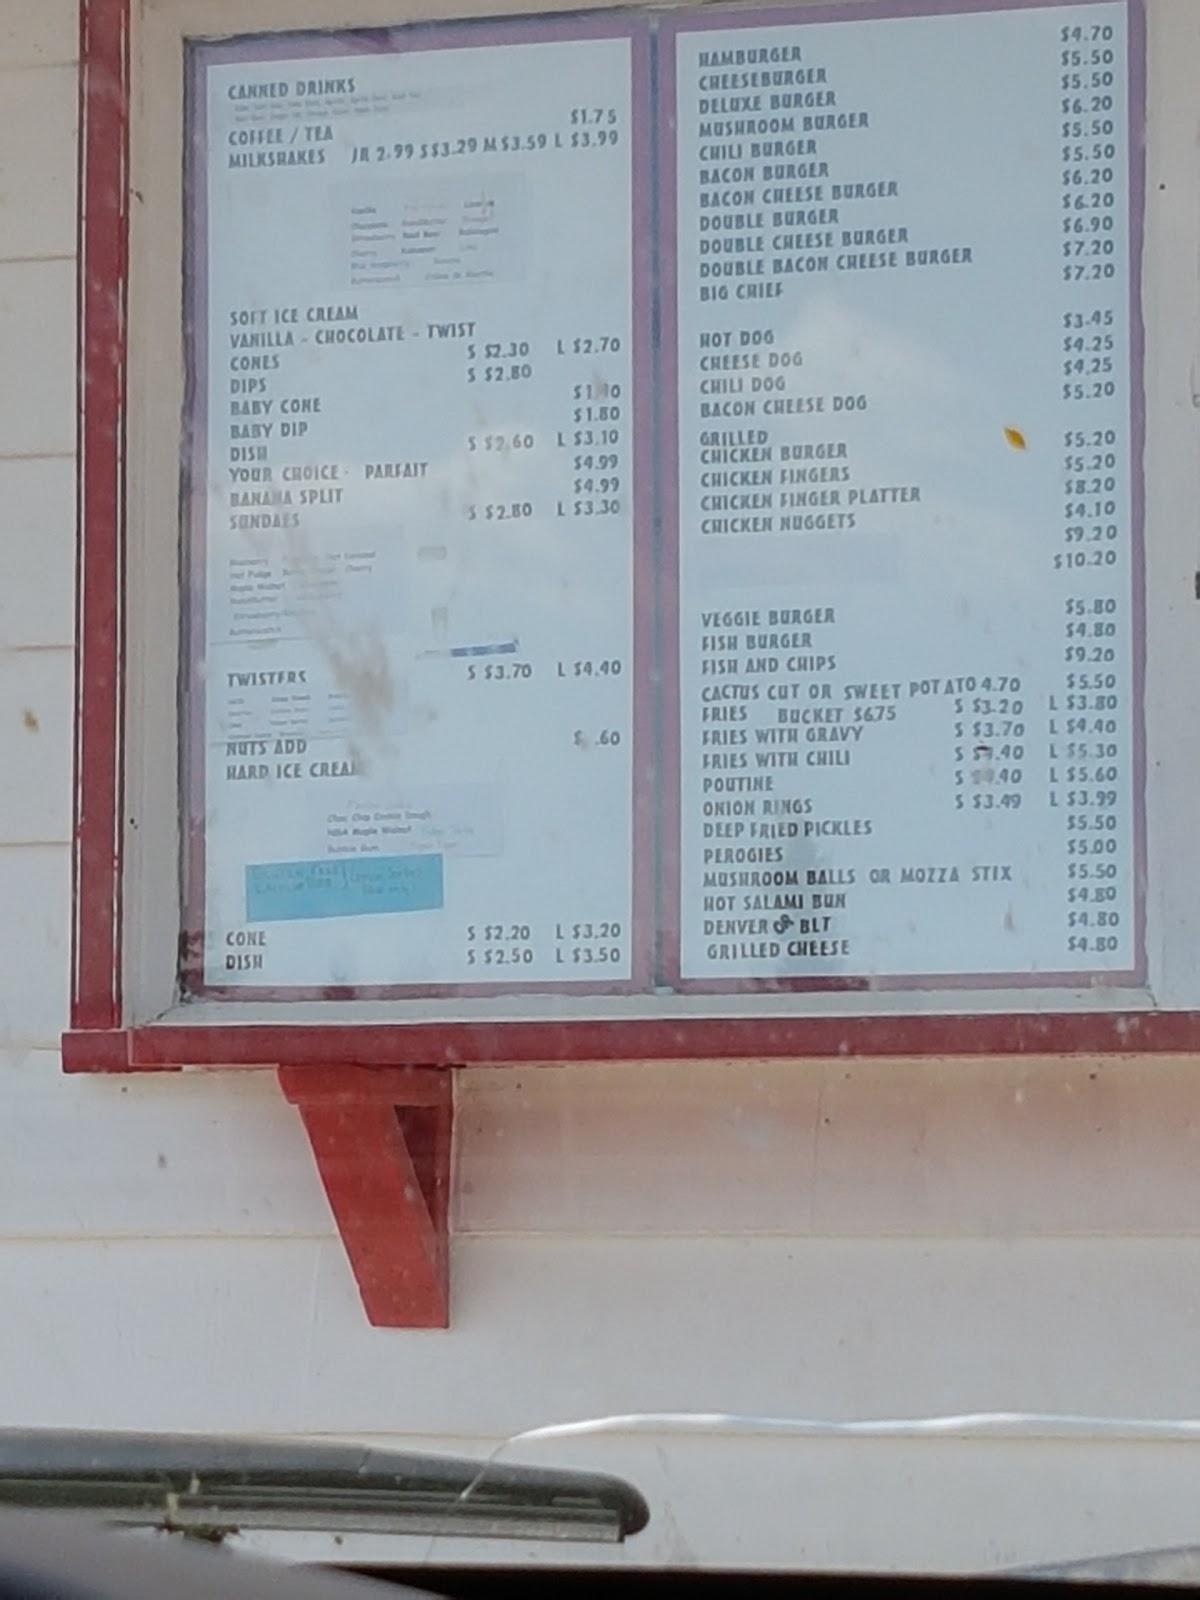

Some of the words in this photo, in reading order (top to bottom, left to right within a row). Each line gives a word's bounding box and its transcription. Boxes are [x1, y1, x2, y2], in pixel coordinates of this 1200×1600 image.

[699, 46, 801, 67] HAMBURGER
[699, 68, 827, 91] CHEESEBURGER
[1062, 49, 1113, 66] $5.50
[228, 82, 288, 100] CANNED
[296, 78, 355, 96] DRINKS
[699, 96, 761, 114] DELUXE
[770, 91, 836, 110] BURGER
[229, 128, 283, 146] COFFEE
[305, 125, 333, 141] TEA
[571, 109, 616, 124] $1.75
[699, 117, 794, 137] MUSHROOM
[803, 112, 868, 131] BURGER
[229, 149, 325, 168] MILKSHAKES
[377, 143, 414, 161] 2.99
[432, 137, 477, 158] $3.29
[501, 134, 546, 151] $3.59
[571, 130, 618, 147] $3.99
[699, 144, 742, 161] CHILI
[751, 139, 816, 158] BURGER
[1062, 120, 1113, 138] $5.50
[700, 167, 754, 185] BACON
[763, 162, 829, 181] BURGER
[700, 190, 754, 208] BACON
[762, 185, 823, 204] CHEESE
[832, 181, 898, 200] BURGER
[1062, 168, 1113, 186] $6.20
[700, 213, 764, 231] DOUBLE
[773, 208, 838, 227] BURGER
[700, 236, 764, 254] DOUBLE
[773, 232, 833, 250] CHEESE
[842, 228, 908, 246] BURGER
[700, 259, 764, 278] DOUBLE
[773, 256, 828, 274] BACON
[836, 252, 897, 270] CHEESE
[906, 248, 972, 266] BURGER
[1063, 240, 1114, 257] $7.20
[700, 285, 728, 301] BIG
[736, 282, 783, 299] CHIEF
[230, 310, 266, 326] SOFT
[275, 309, 298, 324] ICE
[307, 306, 358, 322] CREAM
[230, 331, 294, 348] VANILLA
[315, 326, 404, 344] CHOCOLATE
[428, 322, 475, 338] TWIST
[700, 332, 732, 348] HOT
[740, 330, 774, 346] DOG
[230, 354, 279, 371] CONES
[485, 342, 529, 359] $2.30
[574, 337, 620, 353] $2.70
[700, 354, 760, 371] CHEESE
[769, 351, 802, 368] DOG
[231, 377, 266, 394] DIPS
[485, 364, 532, 382] $2.80
[700, 377, 743, 394] CHILI
[752, 376, 785, 392] DOG
[231, 400, 273, 415] BABY
[280, 398, 320, 414] CONE
[701, 401, 755, 418] BACON
[763, 397, 824, 415] CHEESE
[833, 395, 867, 411] DOG
[1063, 381, 1115, 400] $5.20
[230, 423, 273, 439] BABY
[281, 421, 307, 437] DIP
[574, 406, 620, 423] $1.80
[574, 429, 618, 446] $3.10
[700, 430, 768, 447] GRILLED
[701, 447, 772, 464] CHICKEN
[781, 443, 847, 461] BURGER
[229, 467, 272, 482] YOUR
[365, 462, 428, 479] PARFAIT
[574, 454, 618, 470] $4.99
[701, 470, 772, 488] CHICKEN
[780, 467, 850, 484] FINGERS
[1065, 453, 1115, 472] $5.20
[300, 488, 343, 505] SPLIT
[574, 477, 619, 494] $4.99
[701, 493, 772, 511] CHICKEN
[780, 490, 840, 508] FINGER
[848, 487, 920, 505] PLATTER
[486, 503, 532, 520] $2.80
[701, 517, 772, 534] CHICKEN
[780, 513, 855, 531] NUGGETS
[1065, 525, 1117, 542] $9.20
[702, 611, 760, 627] VEGGIE
[769, 608, 835, 626] BURGER
[1066, 598, 1116, 616] $5.80
[702, 635, 738, 651] FISH
[746, 633, 812, 650] BURGER
[485, 663, 532, 680] $3.70
[574, 660, 621, 676] $4.40
[702, 659, 738, 675] FISH
[745, 657, 779, 673] AND
[786, 655, 836, 672] CHIPS
[702, 684, 759, 702] CACTUS
[767, 684, 800, 700] CUT
[844, 684, 901, 700] SWEET
[981, 677, 1020, 692] 4.70
[1067, 673, 1116, 690] $5.50
[703, 706, 747, 722] FRIES
[778, 708, 843, 724] BUCKET
[973, 697, 1023, 715] $3.20
[703, 729, 747, 745] FRIES
[755, 728, 798, 744] WITH
[806, 726, 863, 742] GRAVY
[973, 721, 1025, 738] $3.70
[1067, 718, 1116, 734] $4.40
[226, 740, 267, 757] NUTS
[274, 739, 307, 754] ADD
[703, 753, 747, 769] FRIES
[755, 752, 798, 768] WITH
[806, 750, 850, 766] CHILI
[227, 765, 269, 780] HARD
[277, 763, 301, 778] ICE
[703, 776, 773, 793] POUTINE
[703, 800, 755, 816] ONION
[973, 794, 1021, 809] $3.49
[704, 822, 744, 838] DEEP
[804, 820, 872, 837] PICKLES
[1067, 815, 1116, 830] $5.50
[704, 847, 783, 864] PEROGIES
[704, 870, 799, 887] MUSHROOM
[807, 869, 855, 885] BALLS
[900, 867, 959, 883] MOZZA
[972, 866, 1012, 881] STIX
[1068, 863, 1117, 879] $5.50
[704, 896, 736, 911] HOT
[744, 894, 803, 910] SALAMI
[812, 894, 845, 909] BUN
[226, 931, 266, 946] CONE
[485, 925, 530, 941] $2.20
[573, 923, 621, 940] $3.20
[704, 919, 768, 935] DENVER
[800, 917, 831, 934] BLT
[485, 948, 533, 964] $2.50
[573, 947, 620, 963] $3.50
[708, 942, 780, 960] GRILLED
[787, 940, 848, 956] CHEESE
[1068, 936, 1118, 952] $4.80
